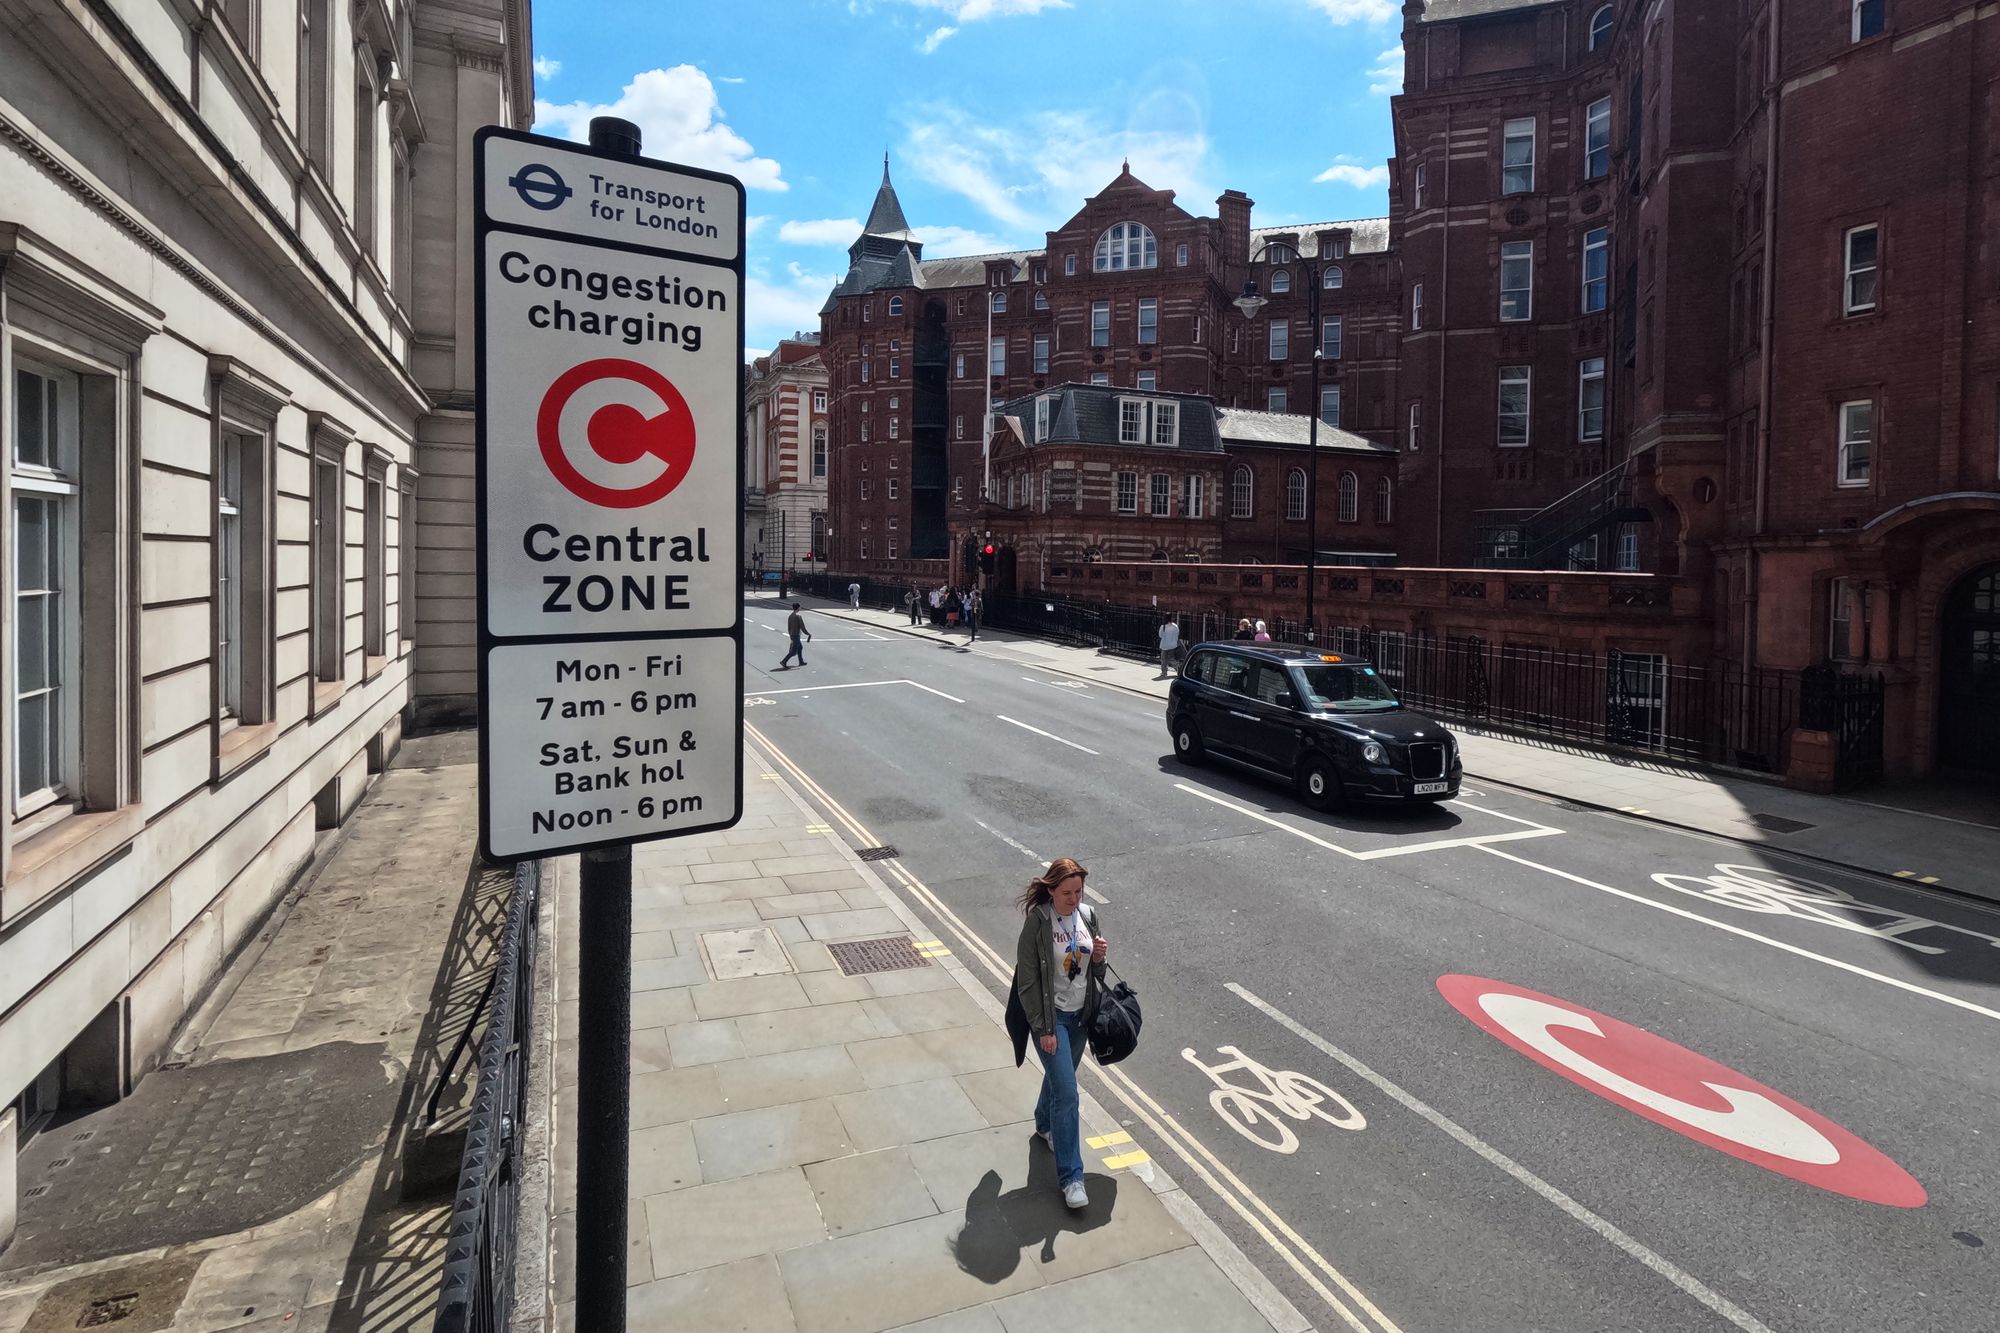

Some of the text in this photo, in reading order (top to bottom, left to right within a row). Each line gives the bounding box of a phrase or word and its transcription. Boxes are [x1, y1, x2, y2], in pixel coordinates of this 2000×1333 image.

[588, 173, 706, 214] Transport
[590, 199, 718, 239] for London
[498, 250, 726, 312] Congestion
[527, 299, 702, 354] charging
[557, 377, 670, 490] C
[522, 522, 710, 563] Central
[542, 574, 691, 613] ZONE
[556, 659, 620, 684] Mon
[646, 654, 682, 678] Fri
[611, 735, 668, 759] Sun
[678, 729, 697, 752] &
[555, 758, 685, 796] Bank hol
[532, 807, 613, 835] Noon
